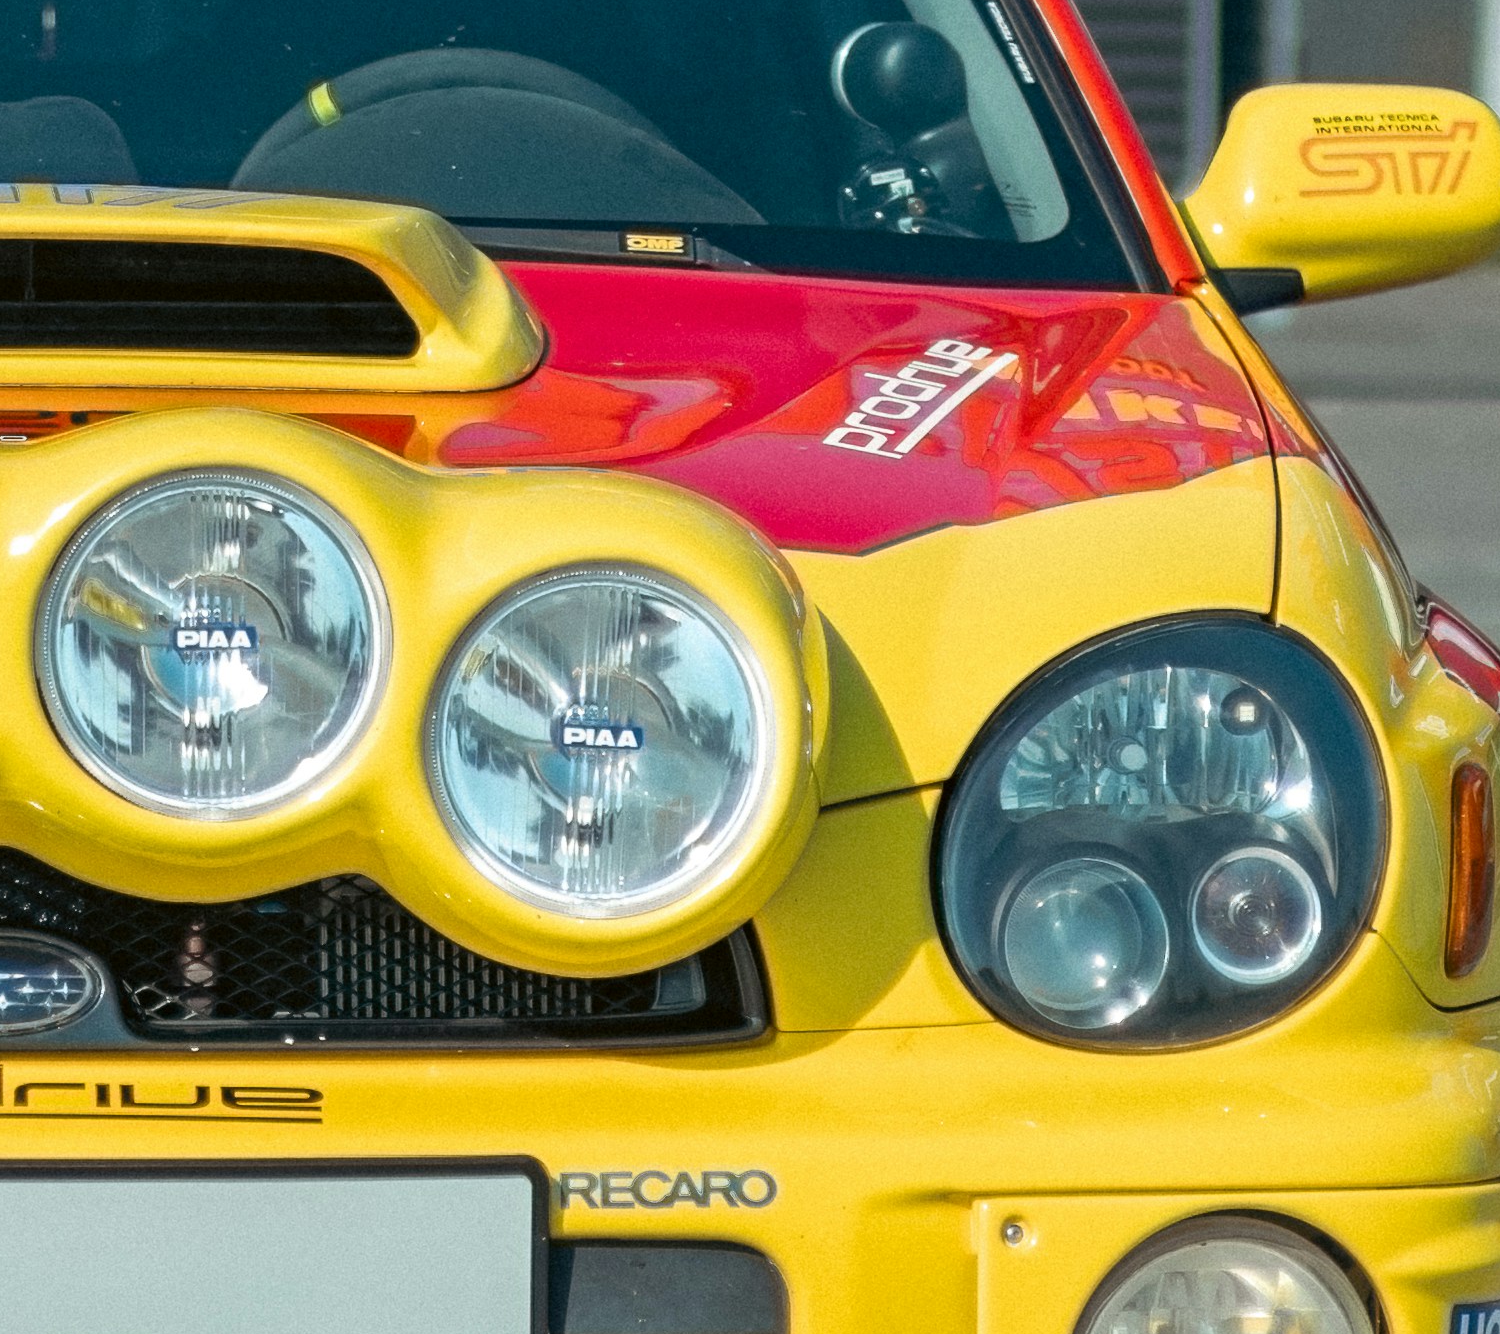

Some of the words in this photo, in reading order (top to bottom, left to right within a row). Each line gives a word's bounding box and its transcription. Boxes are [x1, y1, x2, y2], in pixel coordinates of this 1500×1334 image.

[1312, 114, 1375, 124] SUBARU
[1379, 112, 1440, 122] TECNICA
[1315, 123, 1444, 135] INTERNATIONAL
[626, 236, 685, 252] OMP
[822, 339, 994, 459] prodrive
[176, 630, 252, 649] PIAA
[562, 727, 638, 748] PIAA
[559, 1170, 778, 1210] RECARO
